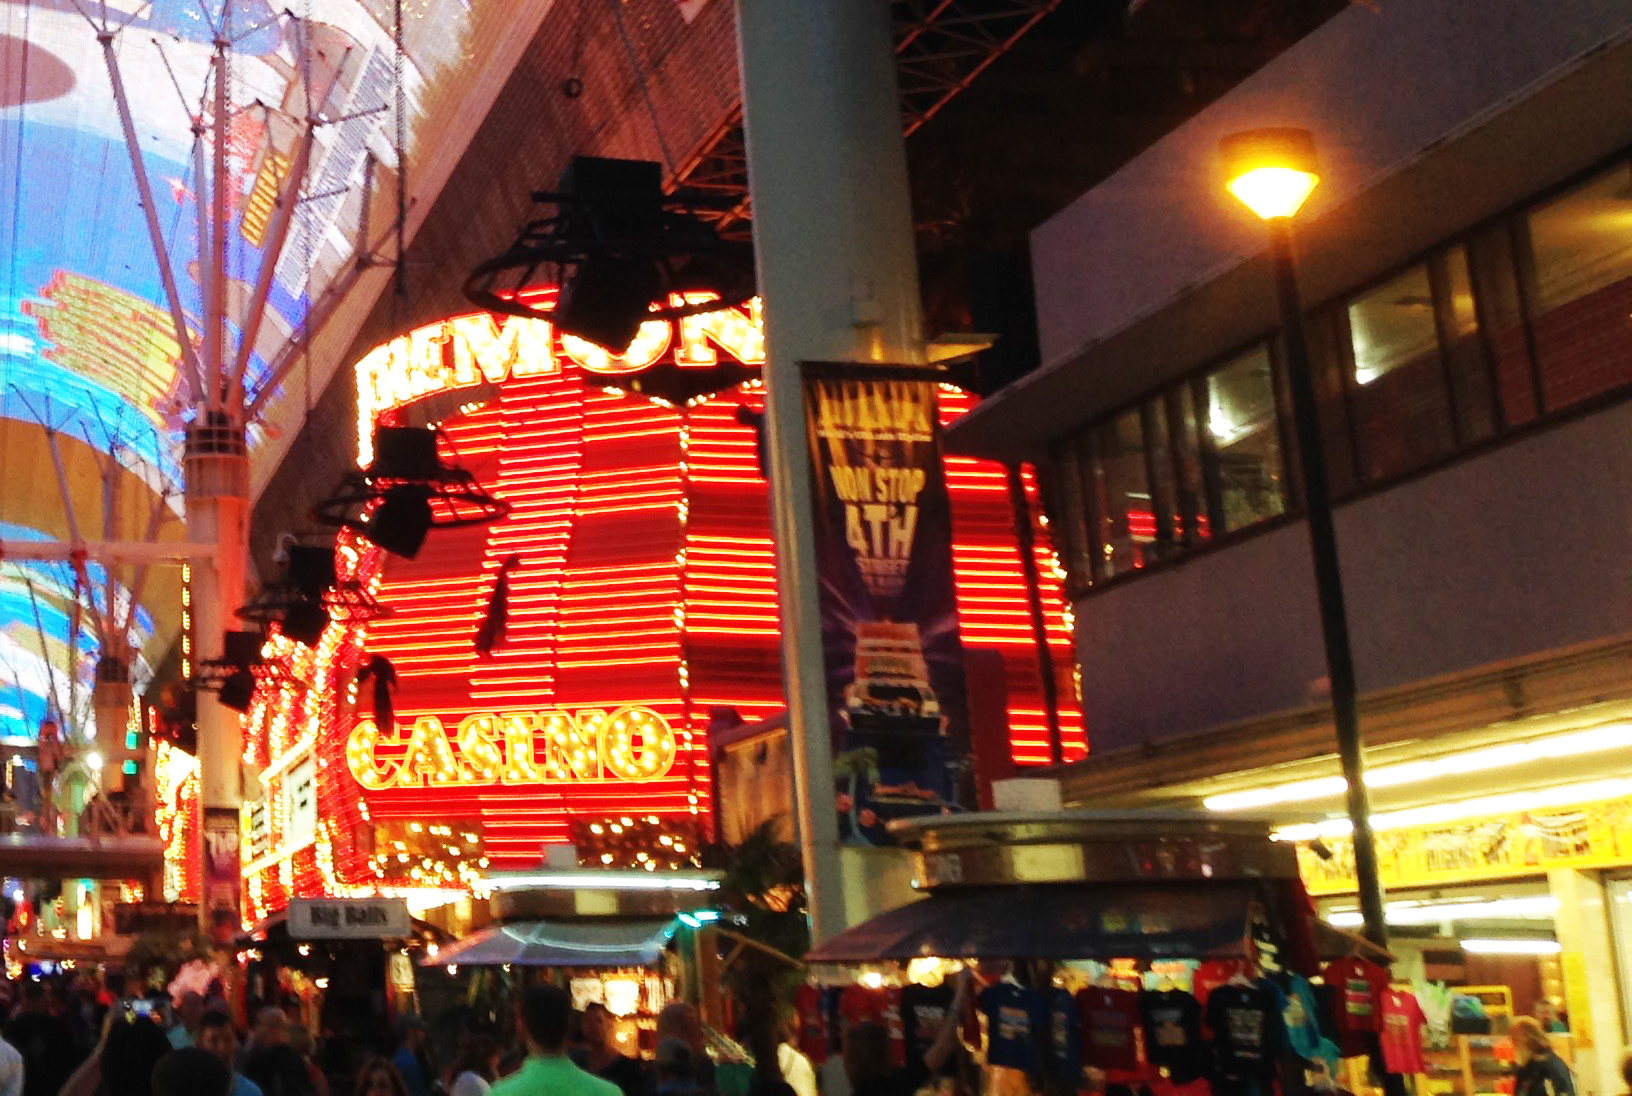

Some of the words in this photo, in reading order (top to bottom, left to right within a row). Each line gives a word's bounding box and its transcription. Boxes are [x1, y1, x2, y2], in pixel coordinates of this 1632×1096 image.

[829, 465, 871, 502] NON
[875, 467, 927, 504] STOP
[845, 502, 919, 560] 4TH
[346, 705, 676, 791] CASINO
